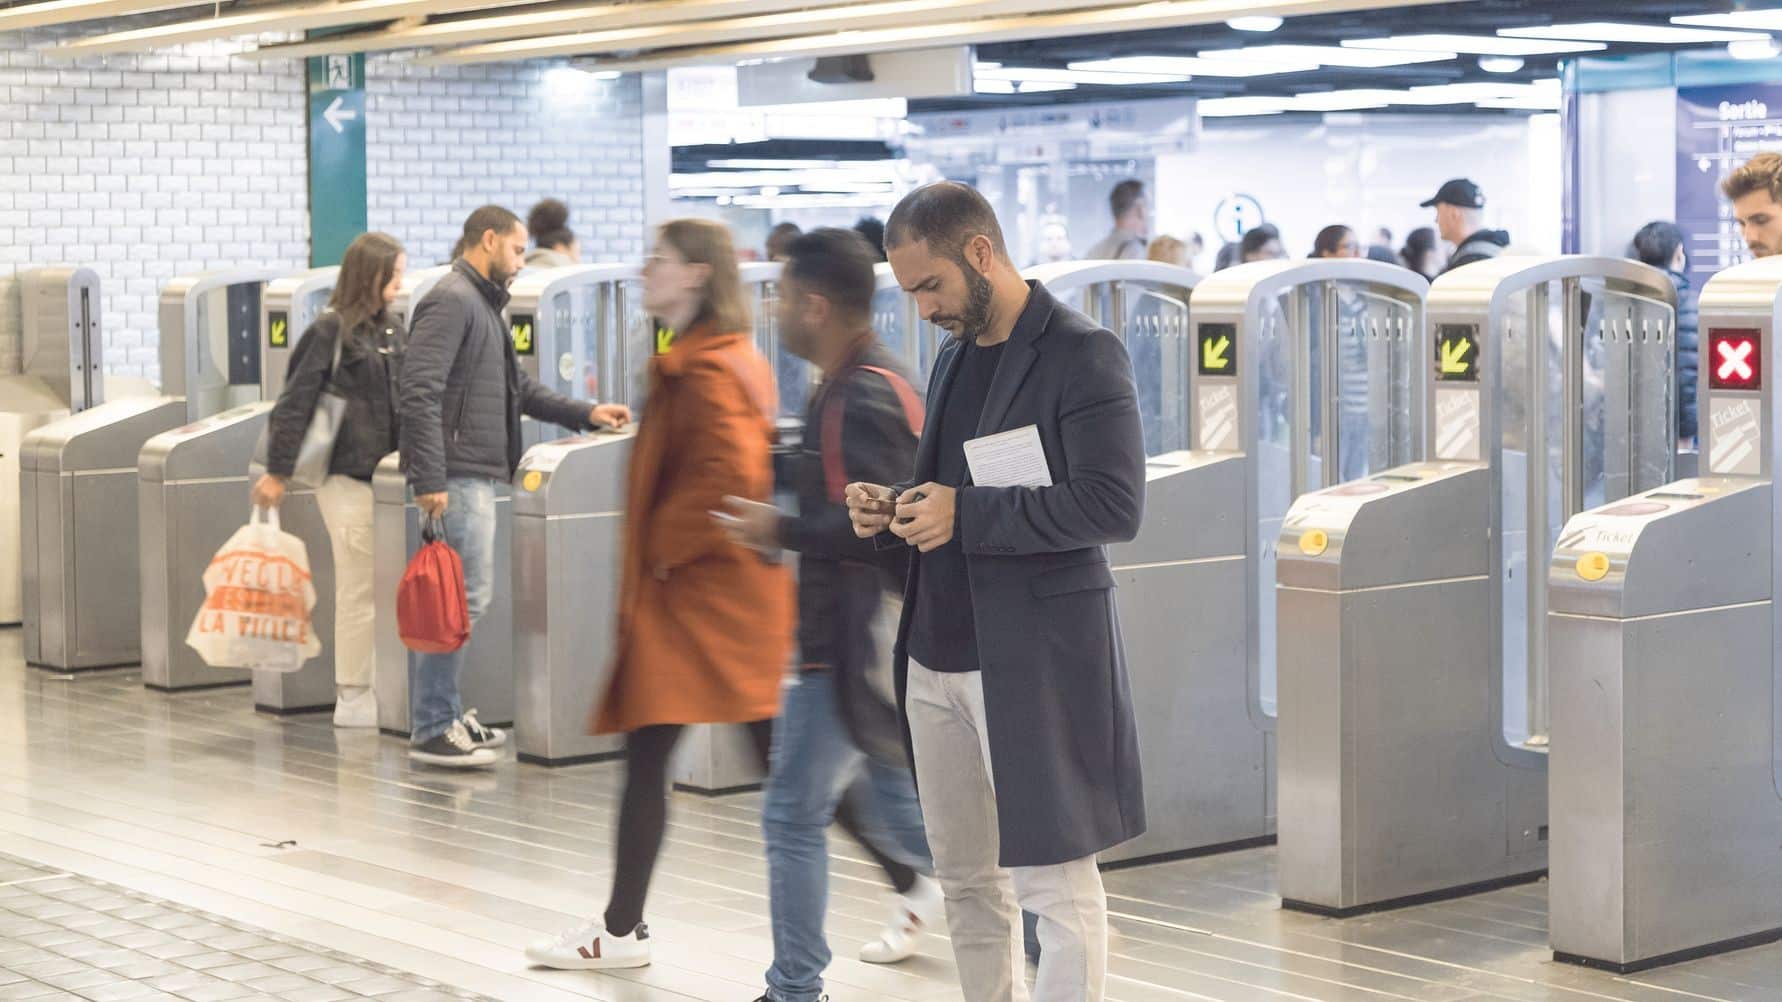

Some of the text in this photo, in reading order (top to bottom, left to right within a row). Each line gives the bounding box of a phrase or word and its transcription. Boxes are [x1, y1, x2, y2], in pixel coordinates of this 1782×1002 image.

[1719, 99, 1767, 120] Sortie
[1712, 400, 1751, 428] Ticket
[1597, 530, 1634, 545] Ticket
